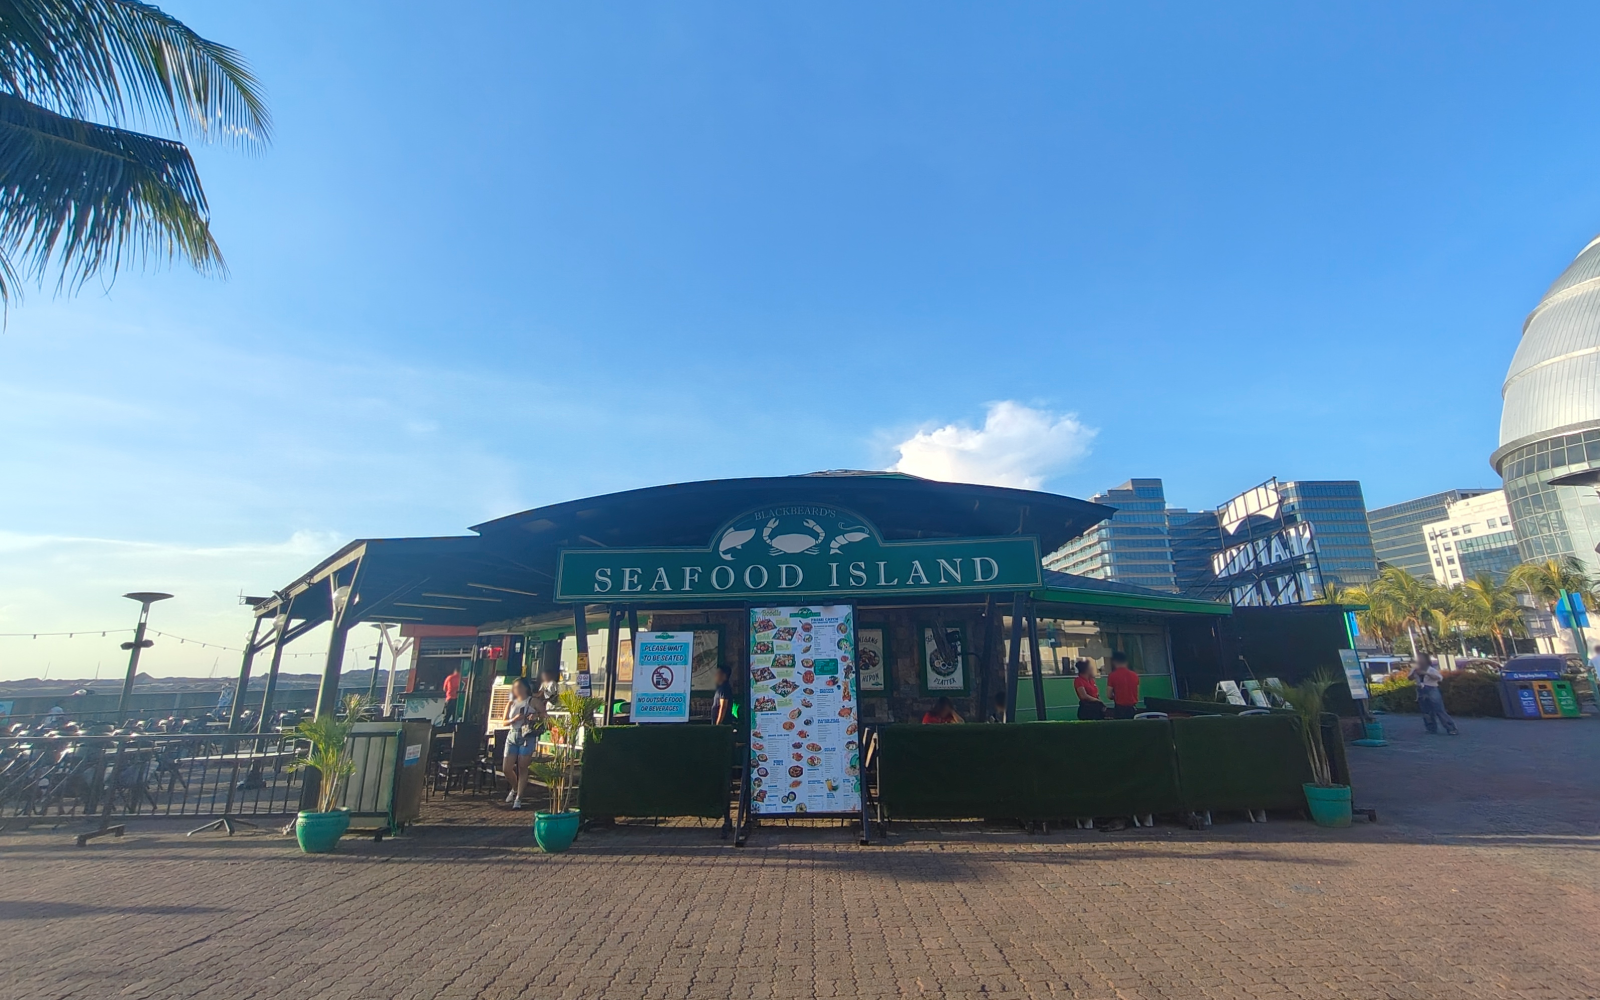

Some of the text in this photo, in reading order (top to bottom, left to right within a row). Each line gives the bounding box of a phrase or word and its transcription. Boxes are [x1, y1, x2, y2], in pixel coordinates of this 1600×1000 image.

[753, 506, 837, 521] BLACKBEARD'S
[593, 556, 1000, 593] SEAFOOD ISLAND
[933, 677, 957, 686] PLATTER
